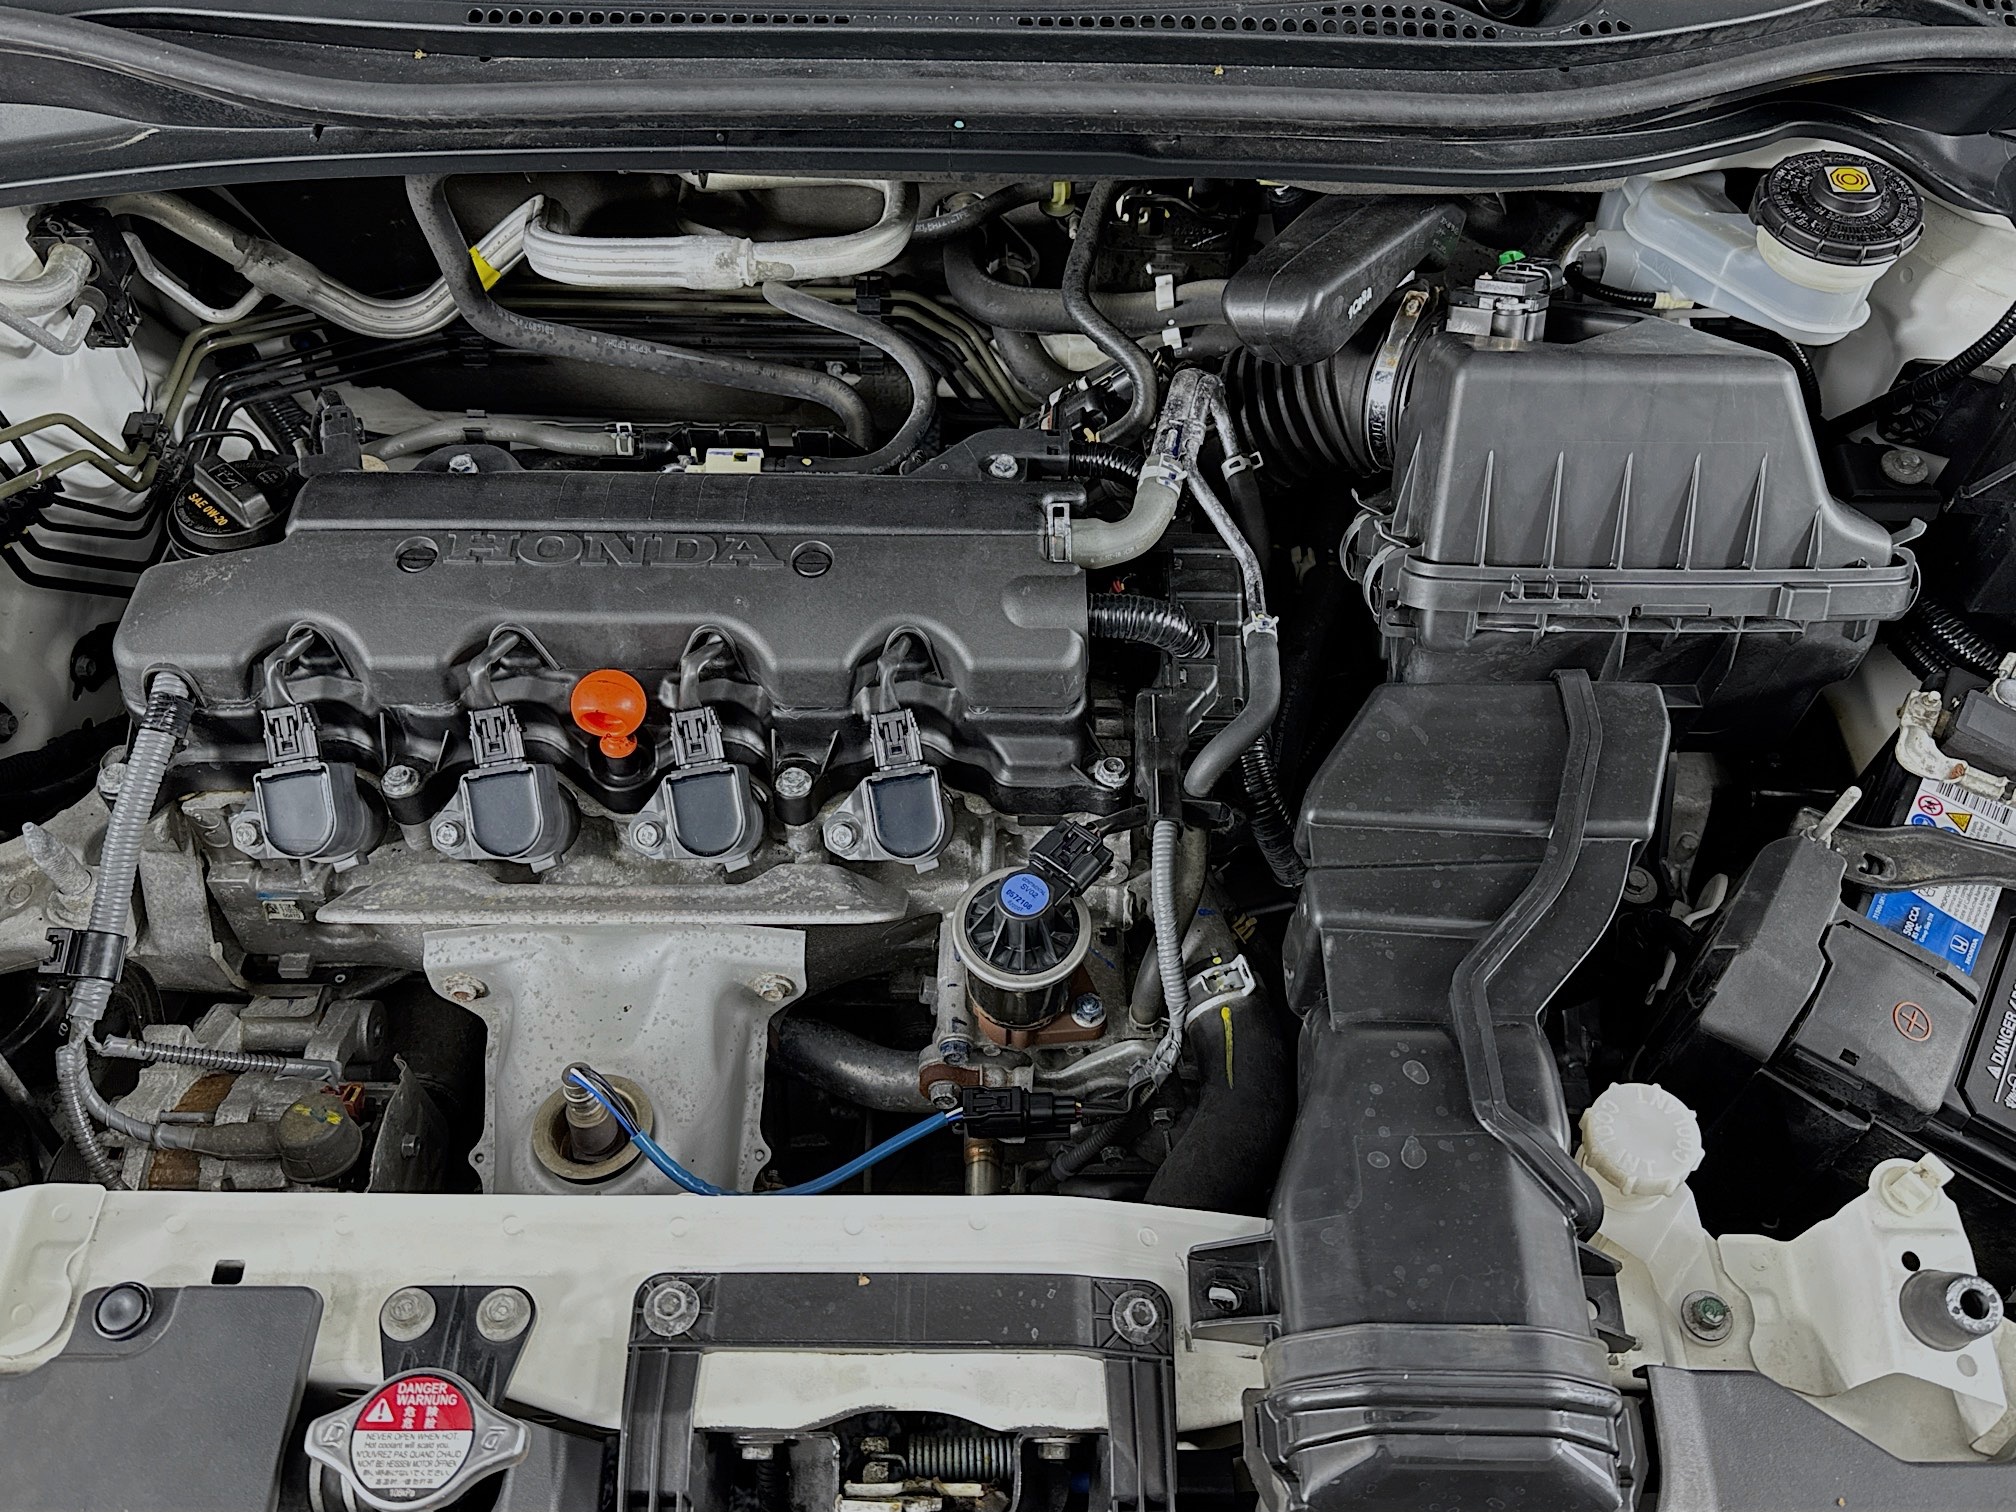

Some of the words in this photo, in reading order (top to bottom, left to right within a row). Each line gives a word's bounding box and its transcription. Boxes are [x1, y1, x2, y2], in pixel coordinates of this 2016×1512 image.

[188, 492, 208, 509] SAE
[203, 504, 228, 526] 0W-20
[443, 532, 786, 568] HONDA
[1908, 906, 1921, 921] CCA
[1903, 920, 1914, 936] 500
[1965, 938, 1979, 965] HONDA
[1991, 1010, 2016, 1067] DANGER
[397, 1382, 449, 1394] DANGER
[396, 1394, 458, 1406] WARNUNG
[366, 1432, 392, 1441] NEVER
[394, 1432, 415, 1441] OPEN
[417, 1432, 440, 1441] WHEN
[442, 1432, 459, 1441] HOT.
[364, 1441, 376, 1449] Hot
[378, 1441, 403, 1449] coolant
[404, 1441, 415, 1449] will
[417, 1441, 435, 1449] scald
[436, 1442, 450, 1450] you.
[393, 1450, 408, 1459] PAS
[409, 1450, 435, 1459] QUAND
[436, 1450, 462, 1459] CHAUD
[412, 1459, 433, 1468] MOTOR
